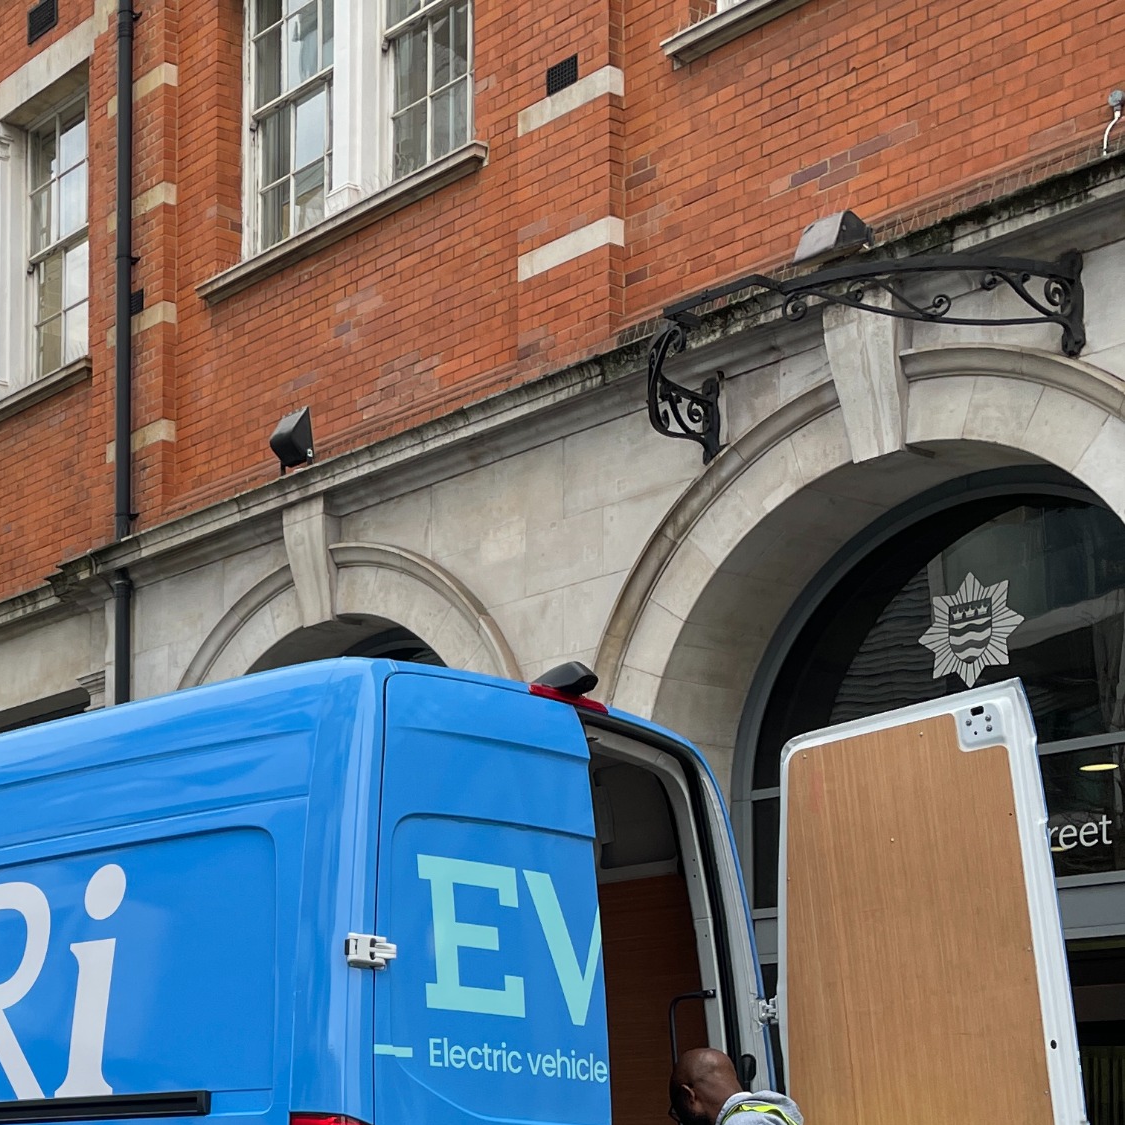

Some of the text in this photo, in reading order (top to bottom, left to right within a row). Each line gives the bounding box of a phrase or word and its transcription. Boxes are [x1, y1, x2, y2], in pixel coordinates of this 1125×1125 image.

[1048, 815, 1112, 850] reet
[429, 1037, 608, 1083] Electric vehicle
